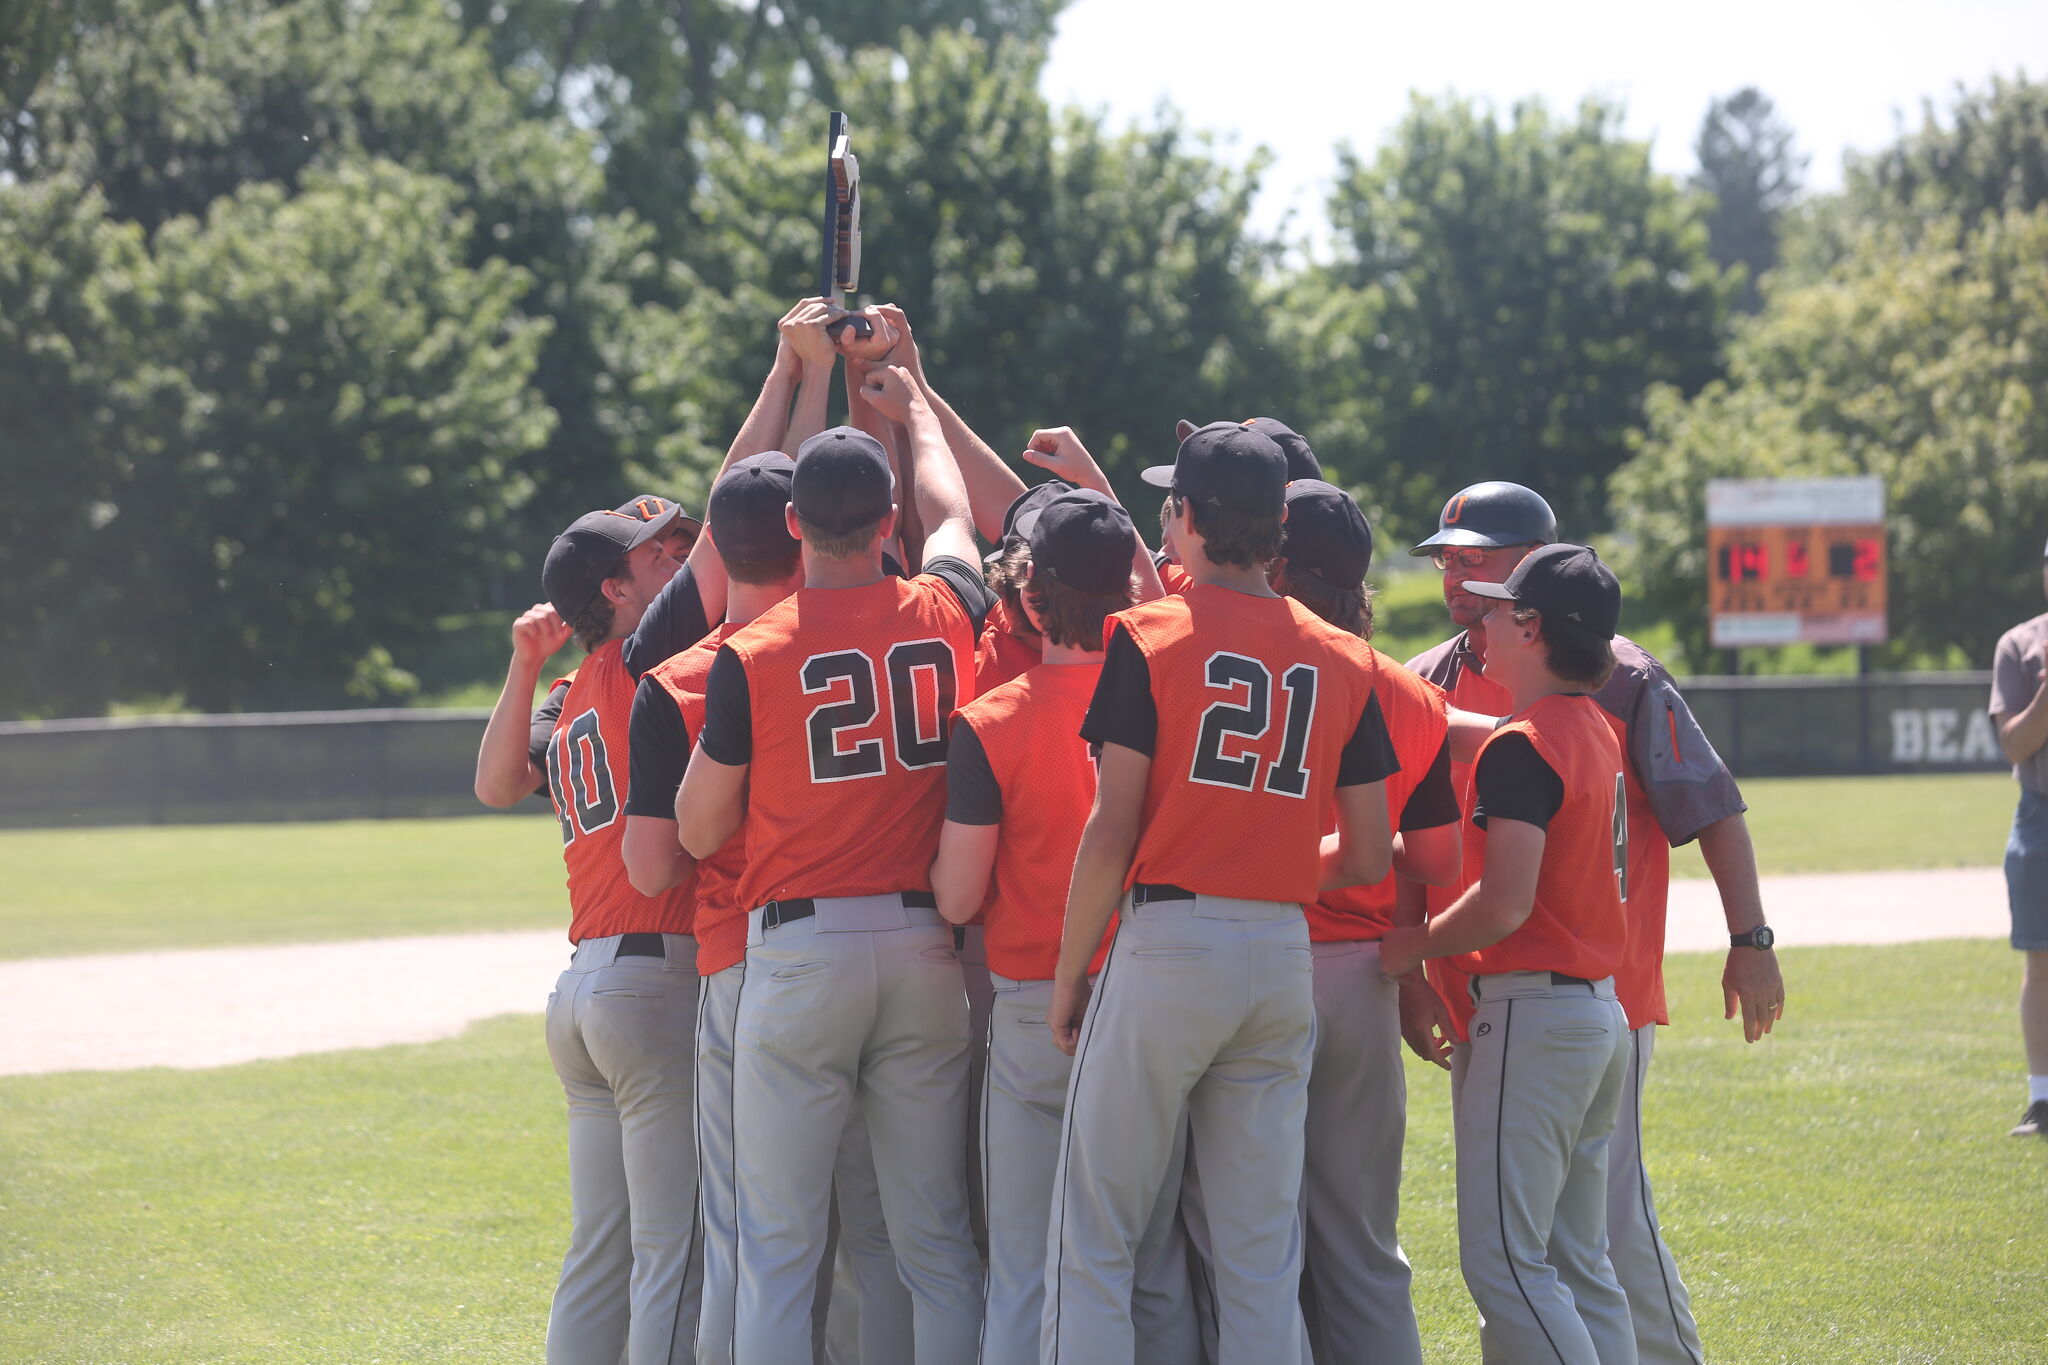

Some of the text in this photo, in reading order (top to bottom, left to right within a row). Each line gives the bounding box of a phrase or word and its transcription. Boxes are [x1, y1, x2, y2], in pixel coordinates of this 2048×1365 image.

[1444, 495, 1468, 525] U
[546, 706, 619, 848] 10
[800, 637, 958, 784] 20
[1188, 650, 1319, 800] 21
